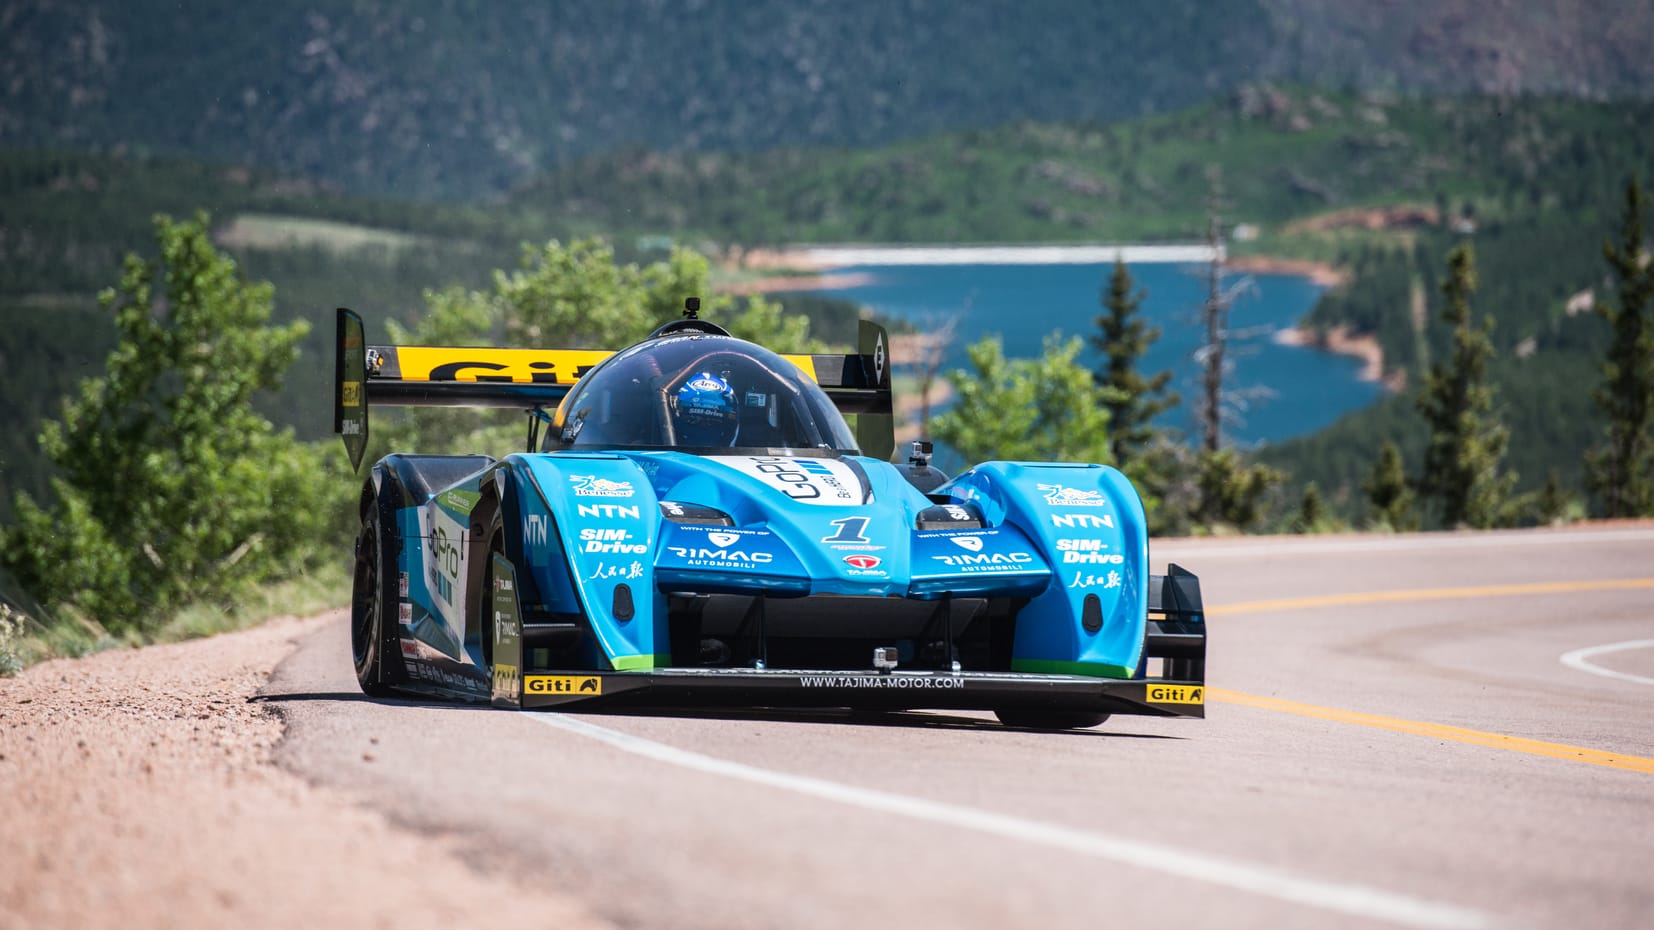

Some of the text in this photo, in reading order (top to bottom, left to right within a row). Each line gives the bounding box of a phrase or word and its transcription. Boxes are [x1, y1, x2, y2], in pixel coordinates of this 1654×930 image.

[578, 504, 640, 519] NTN
[1051, 514, 1114, 528] NTN
[524, 514, 548, 547] NTN
[579, 529, 633, 541] SIM-
[821, 516, 871, 544] 1
[585, 541, 648, 554] Drive
[1056, 538, 1109, 551] SIM-
[688, 559, 756, 569] AUTOMOBILI
[1063, 551, 1124, 564] Drive
[961, 564, 1023, 572] AUTOMOBILI
[529, 679, 571, 692] Giti
[800, 677, 964, 688] WWW.TAJIMA-MOTOR.COM
[1151, 688, 1184, 701] Giti
